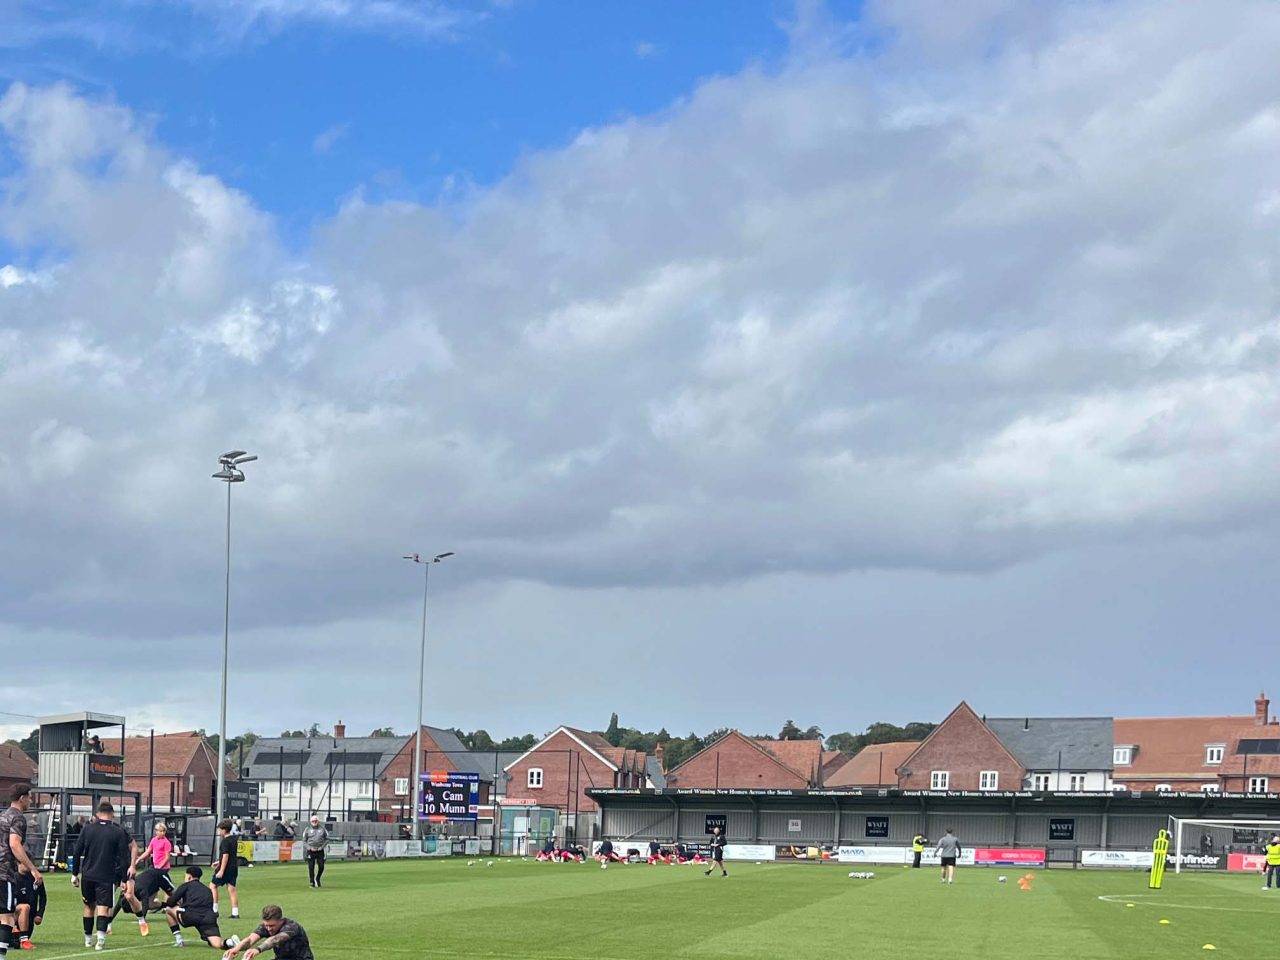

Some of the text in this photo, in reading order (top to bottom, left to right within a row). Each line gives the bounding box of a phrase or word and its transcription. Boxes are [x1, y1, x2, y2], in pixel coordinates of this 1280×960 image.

[442, 791, 463, 801] Cam
[425, 803, 466, 813] 10 Munn
